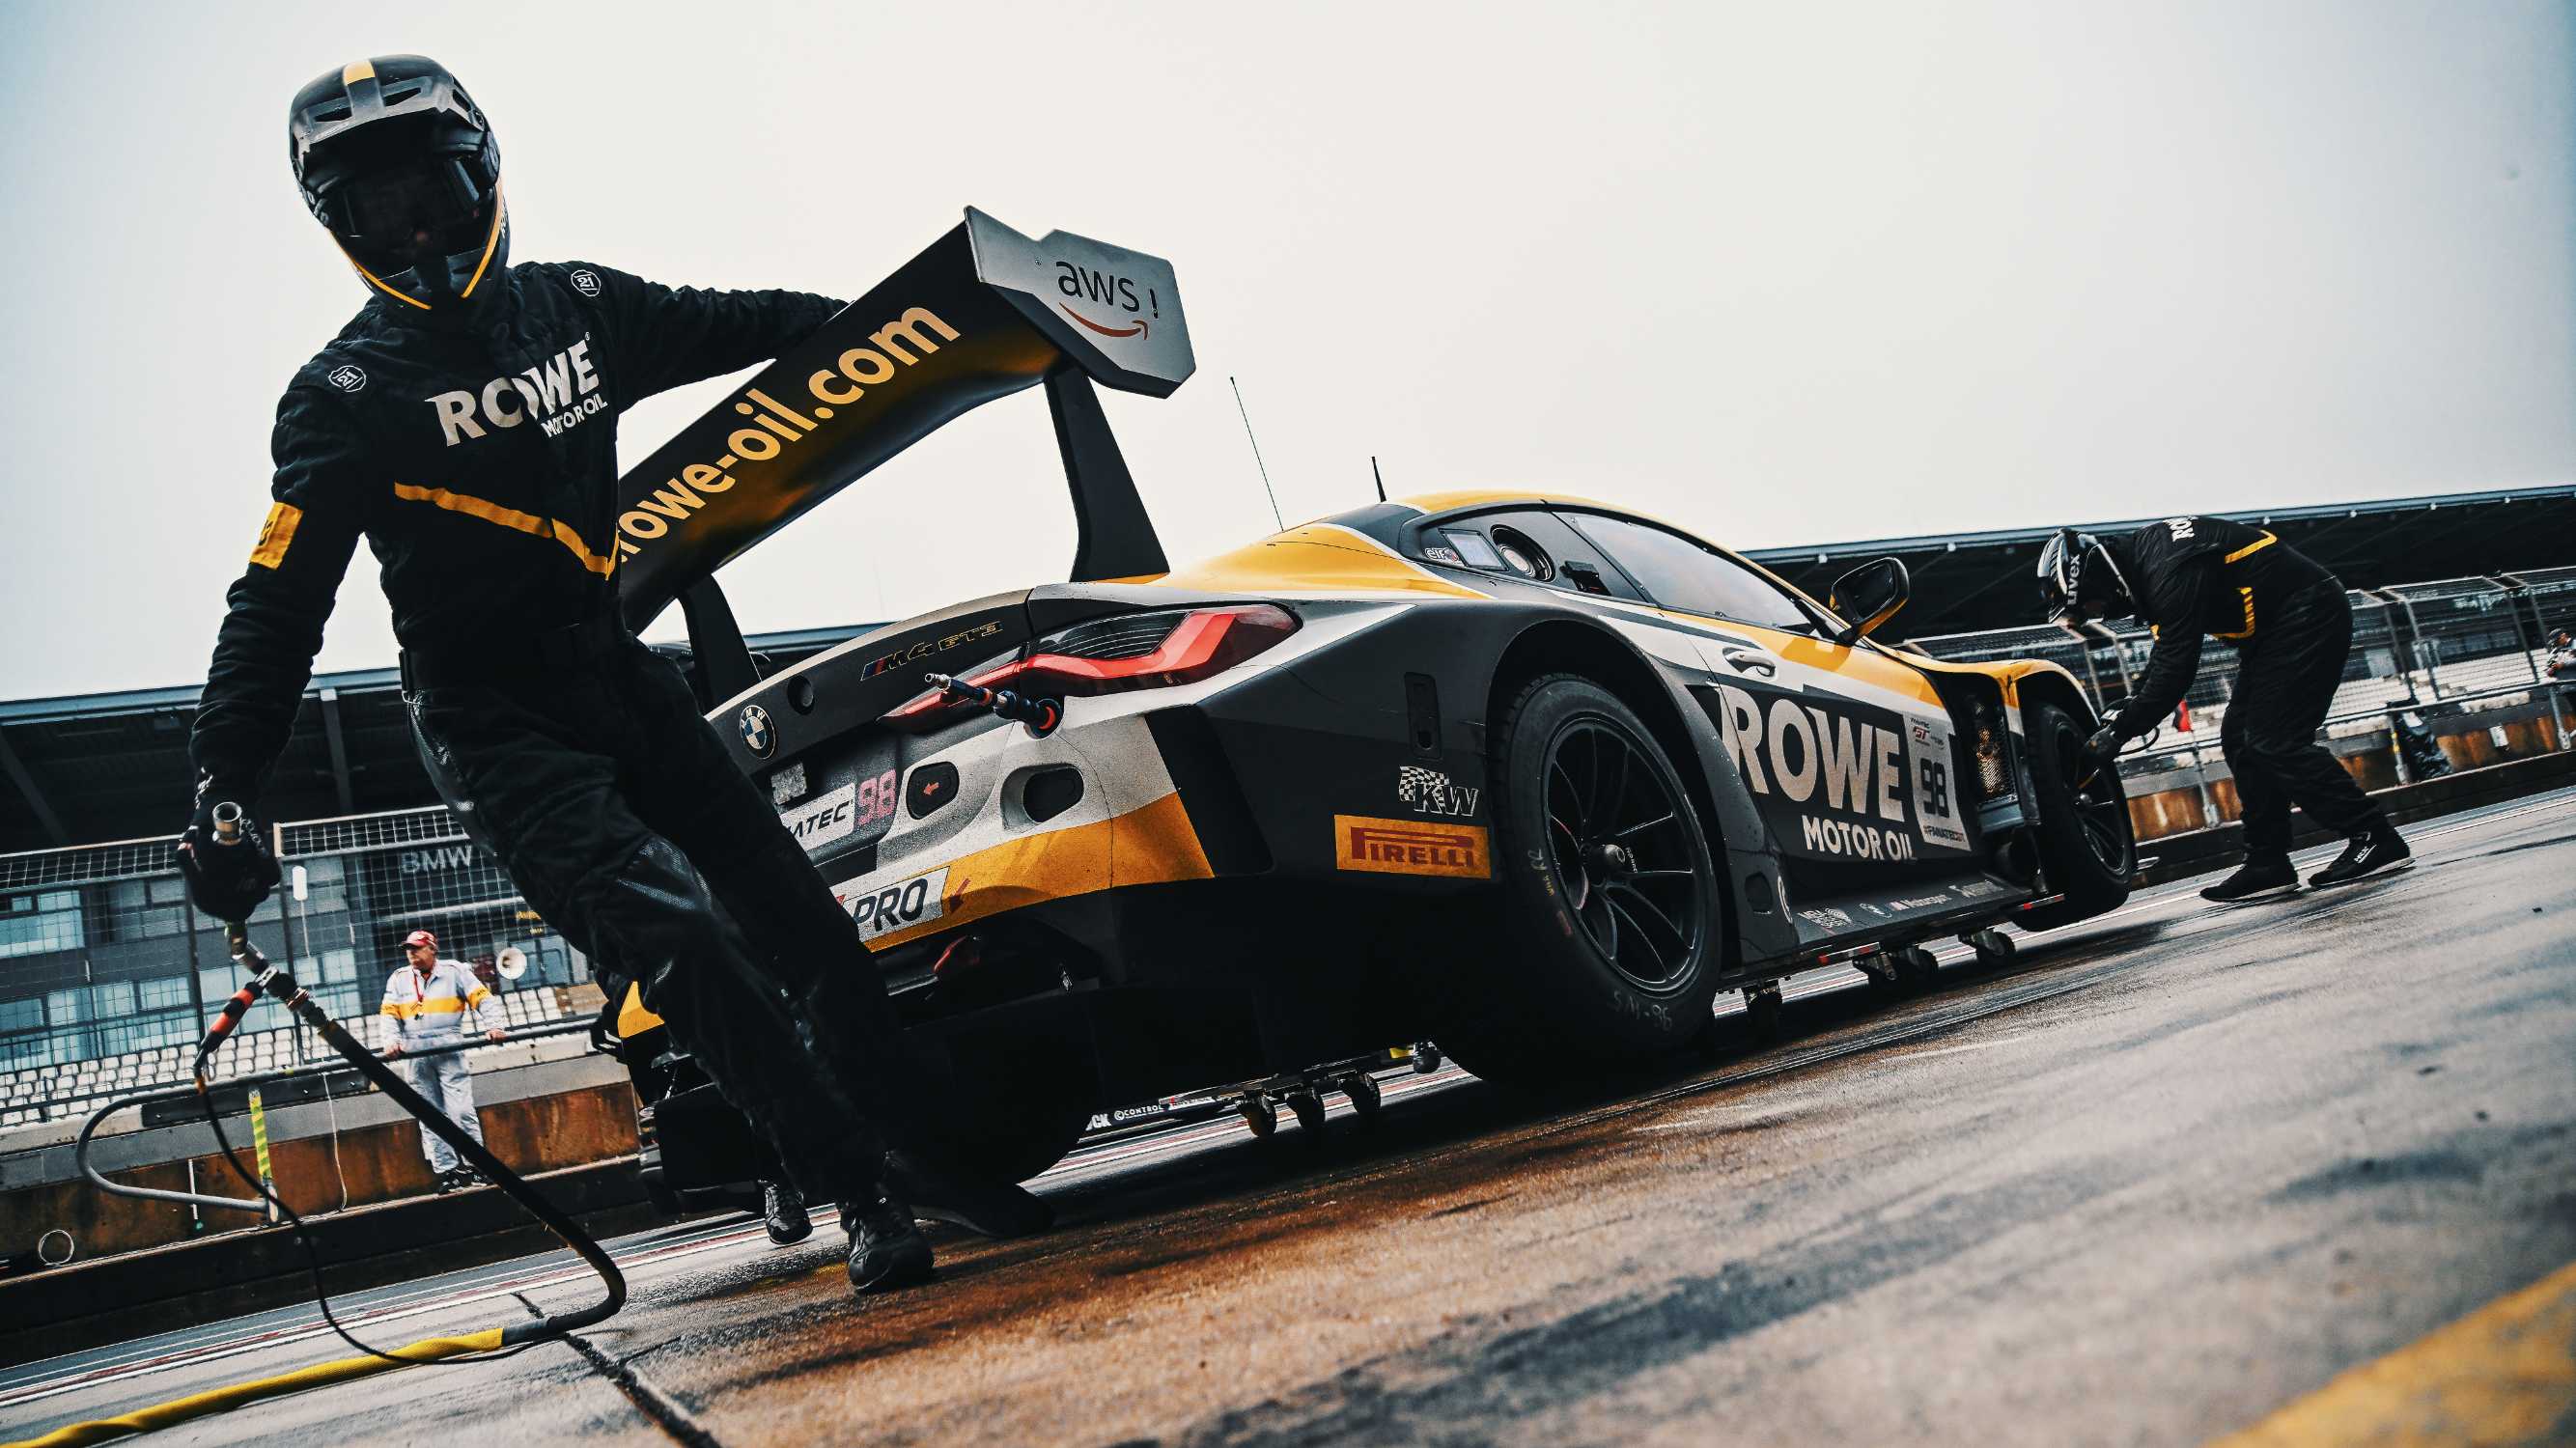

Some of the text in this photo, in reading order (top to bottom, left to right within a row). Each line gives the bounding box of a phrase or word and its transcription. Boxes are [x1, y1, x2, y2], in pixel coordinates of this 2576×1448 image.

[579, 274, 595, 288] 21
[1056, 261, 1140, 313] aws
[337, 371, 358, 387] 21
[425, 339, 601, 447] ROWE
[583, 393, 608, 415] OIL
[2067, 554, 2080, 605] uvex
[1713, 683, 1905, 822] ROWE
[857, 769, 897, 827] 98
[1414, 783, 1479, 817] KW
[1919, 758, 1951, 819] 98
[788, 801, 850, 839] ATEC
[1802, 815, 1918, 861] MOTOR OIL
[402, 844, 472, 874] BMW
[1351, 826, 1475, 867] PIRELLI
[854, 877, 929, 933] PRO
[1124, 1104, 1163, 1117] CONTROL
